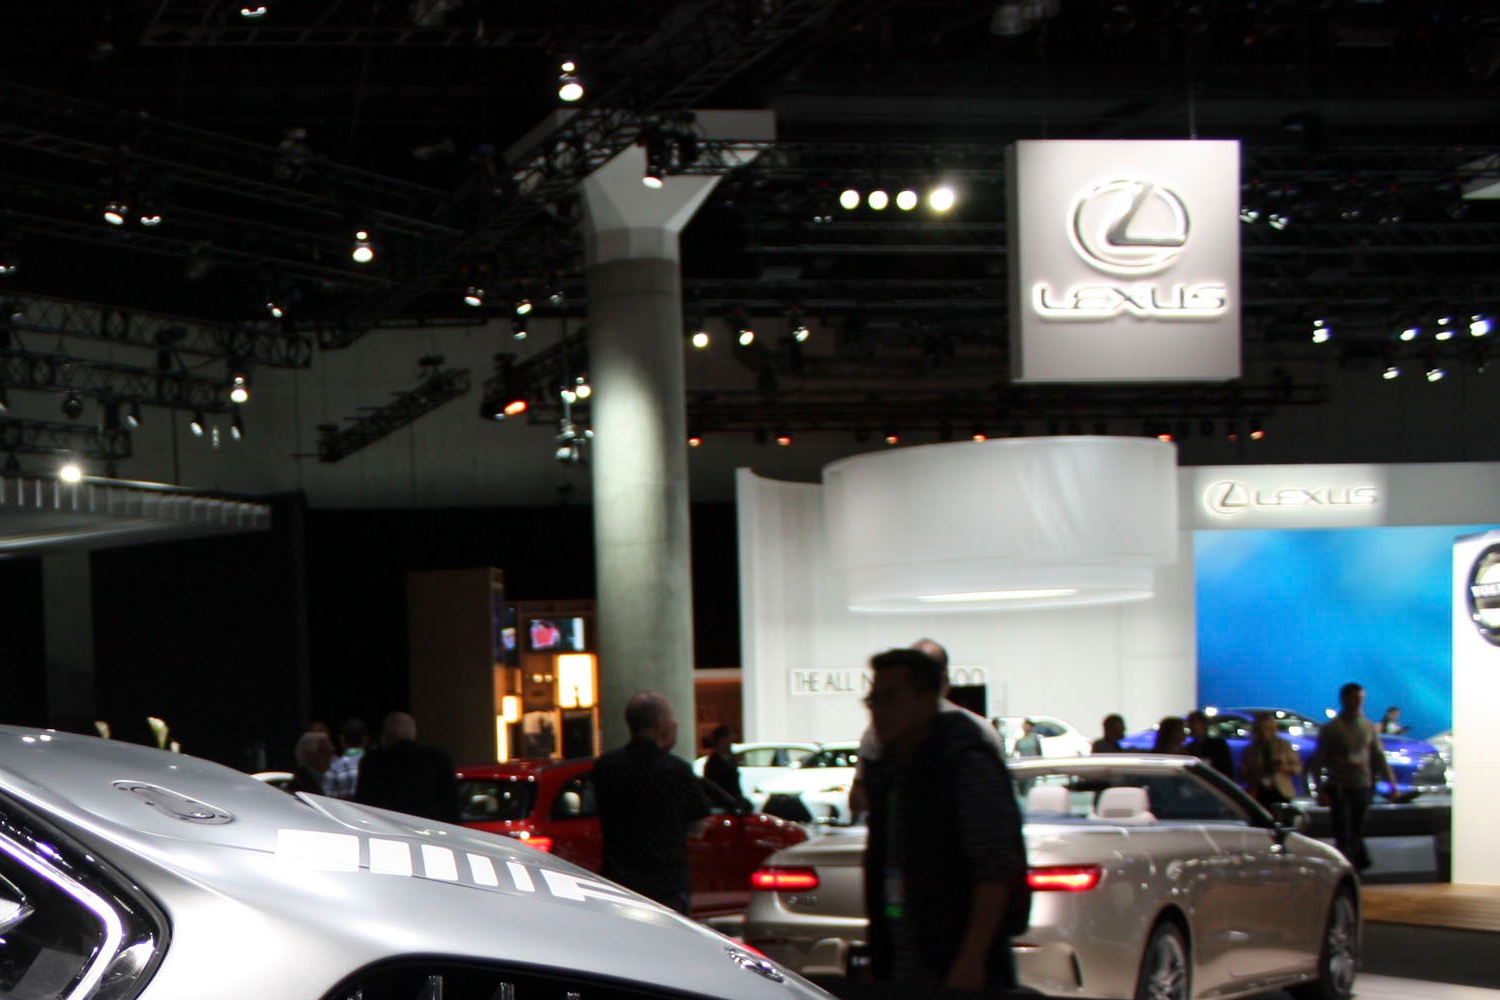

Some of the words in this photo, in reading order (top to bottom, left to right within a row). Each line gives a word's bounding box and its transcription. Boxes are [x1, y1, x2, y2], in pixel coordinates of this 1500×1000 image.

[1035, 284, 1227, 315] LEXUS
[1252, 486, 1379, 507] LEXUS
[793, 671, 820, 692] THE
[823, 671, 855, 692] ALL
